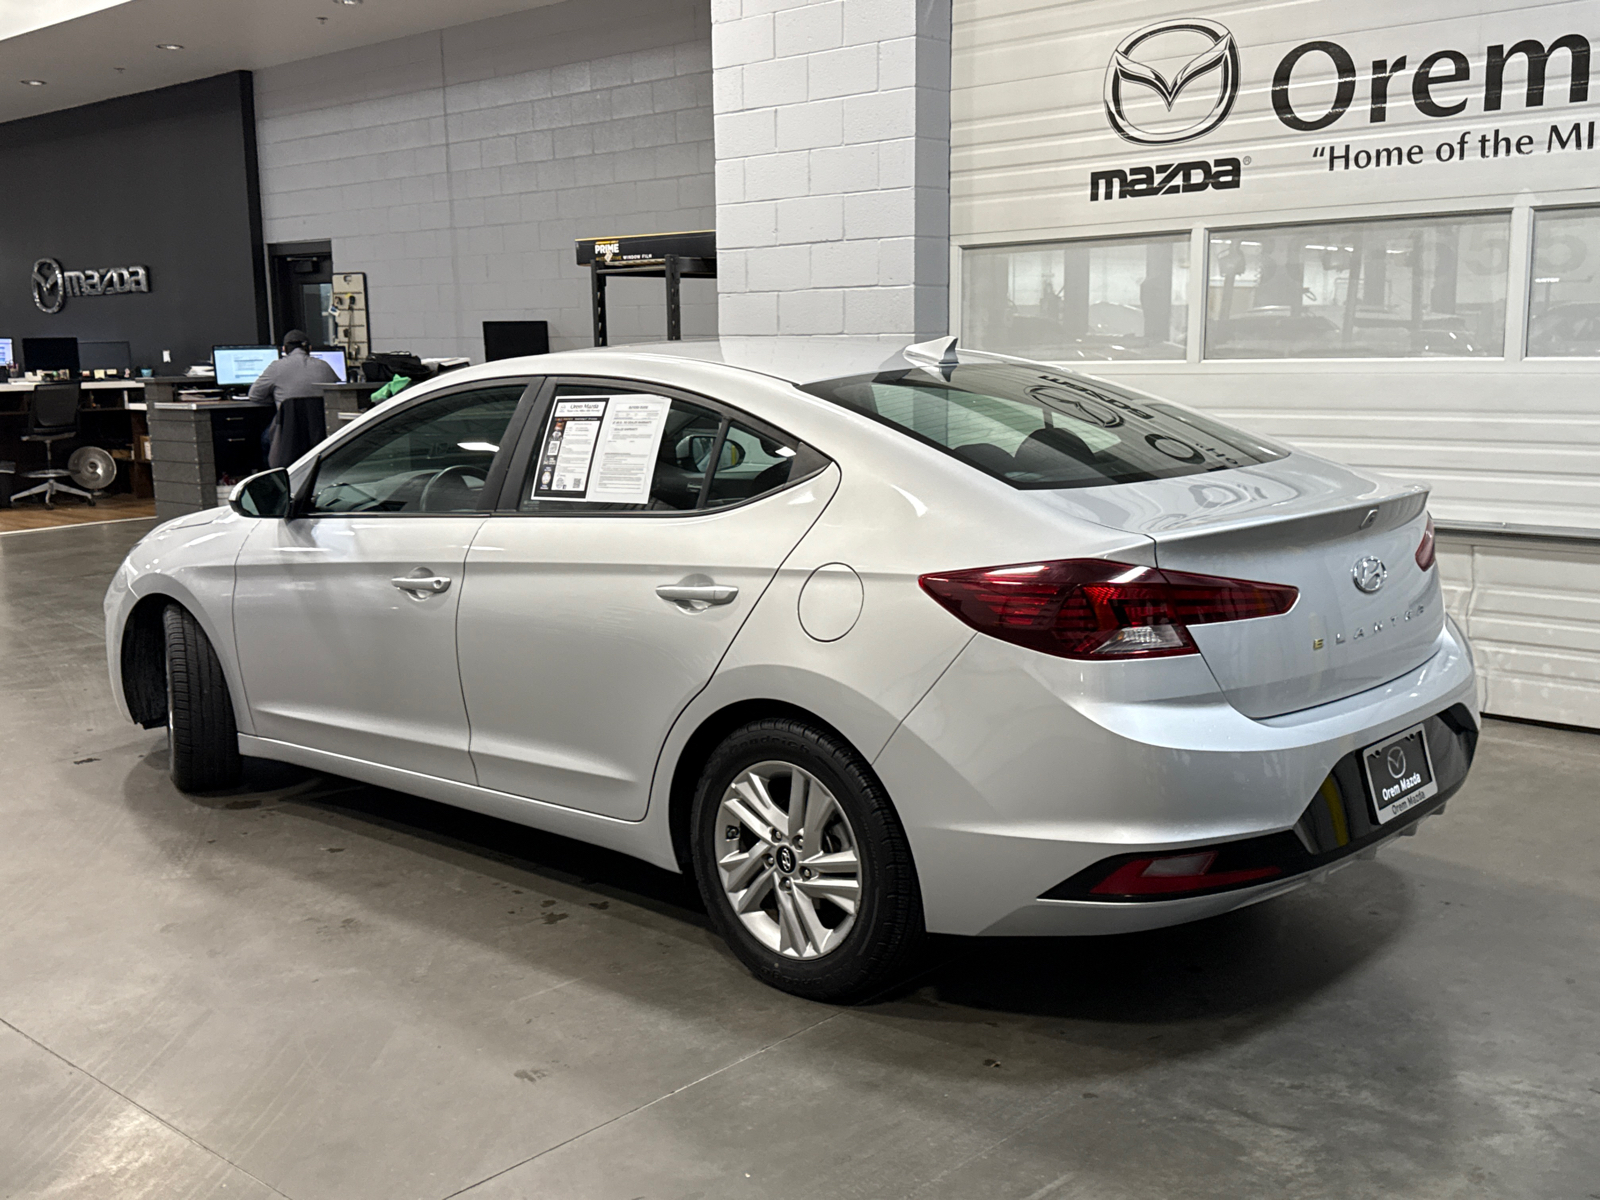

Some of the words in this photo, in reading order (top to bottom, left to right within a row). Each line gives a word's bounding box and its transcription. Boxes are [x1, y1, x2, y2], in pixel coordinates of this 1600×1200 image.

[1271, 33, 1591, 131] Orem
[1435, 131, 1473, 162] of
[1478, 129, 1534, 159] the
[595, 243, 619, 254] PRIME
[1382, 784, 1401, 801] Orem
[1400, 772, 1421, 791] Mazda
[1391, 801, 1408, 815] Orem
[1407, 791, 1425, 806] Mazda
